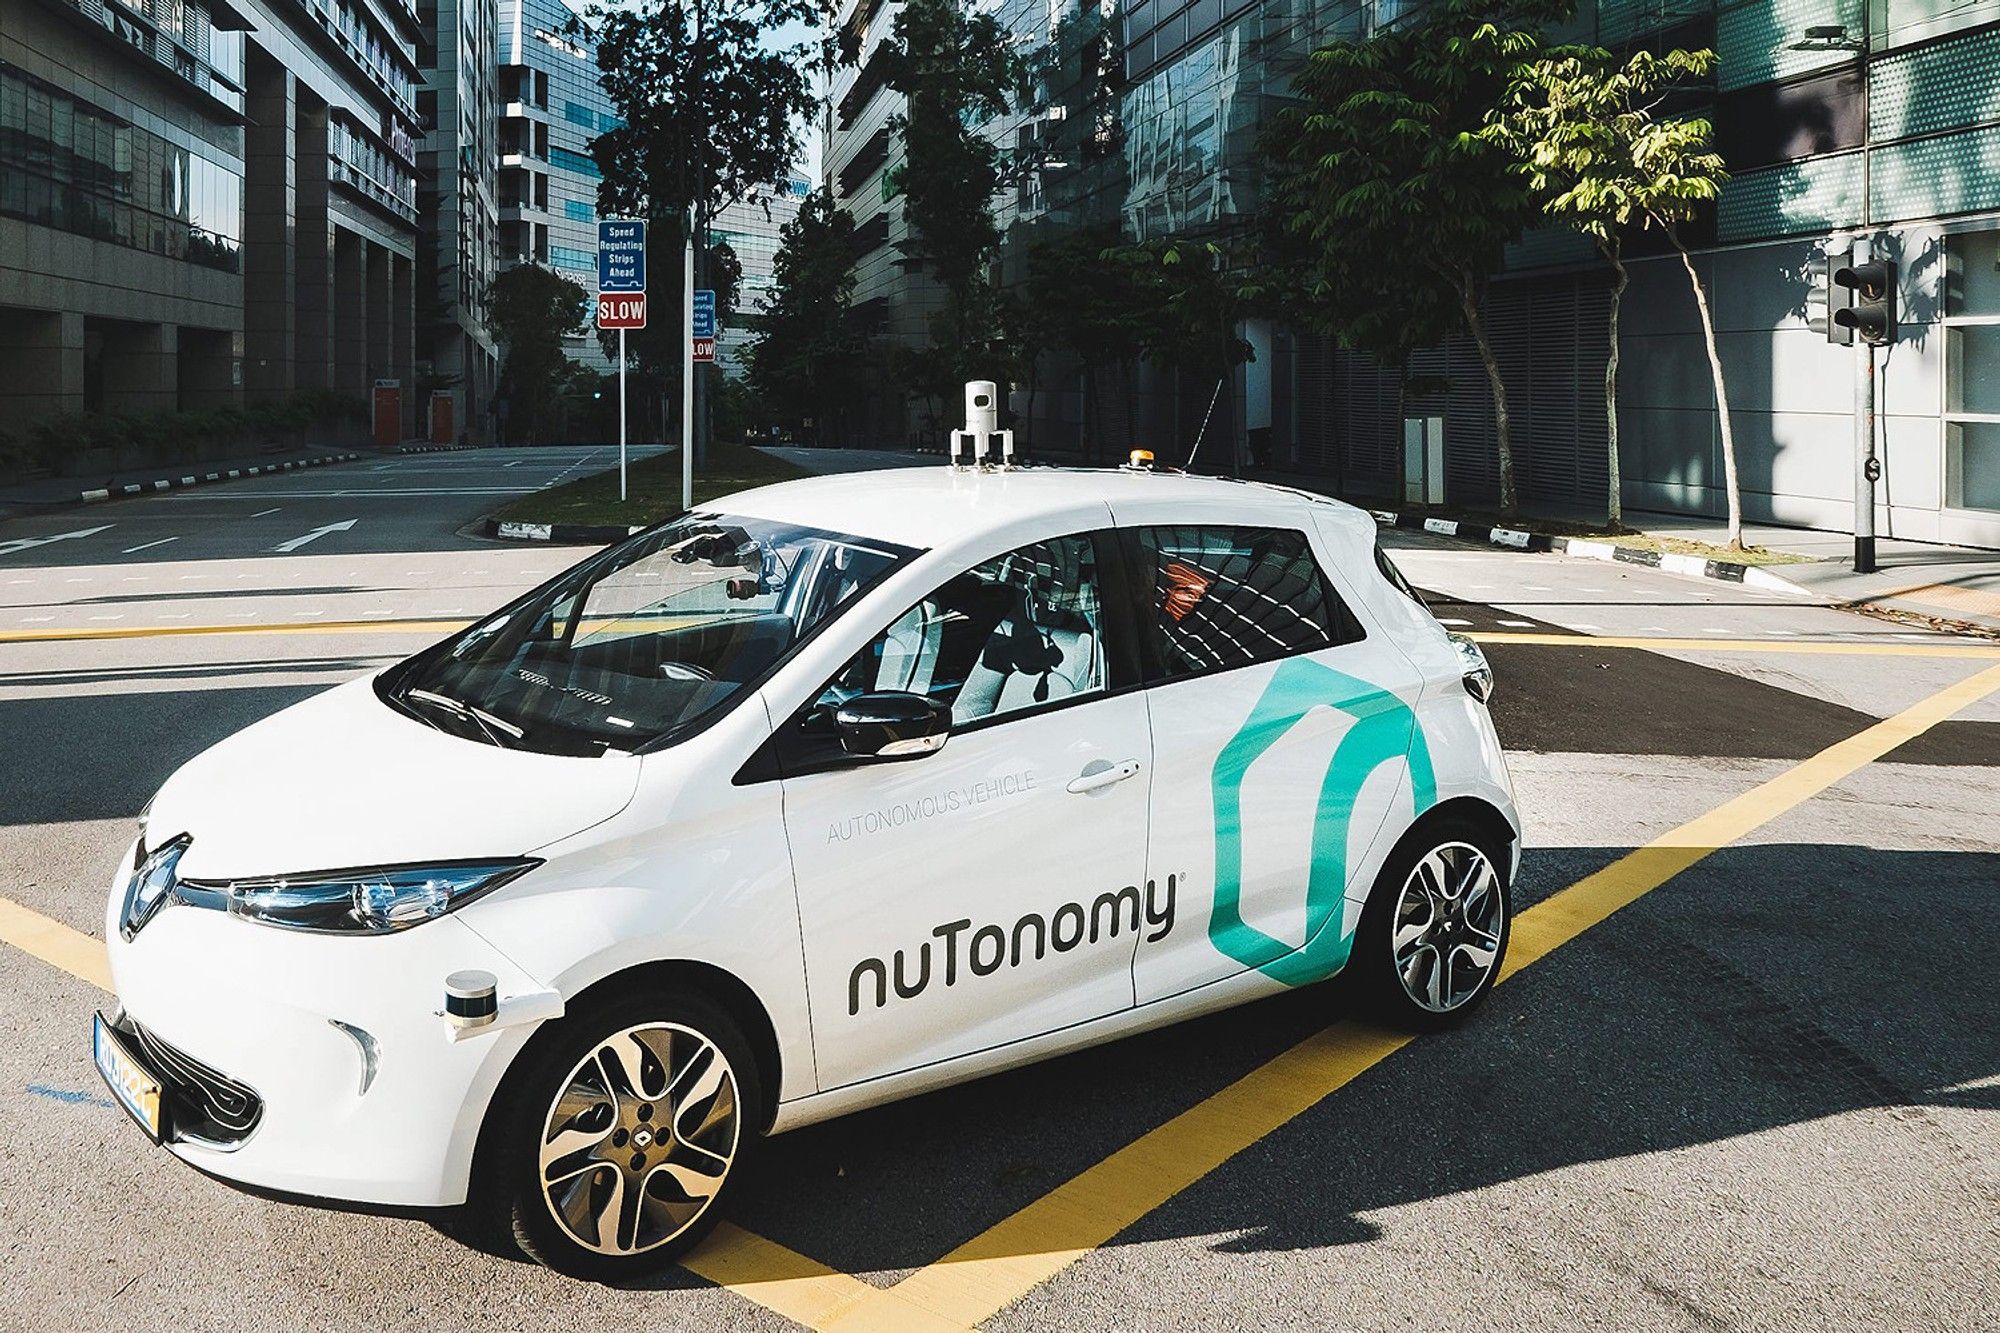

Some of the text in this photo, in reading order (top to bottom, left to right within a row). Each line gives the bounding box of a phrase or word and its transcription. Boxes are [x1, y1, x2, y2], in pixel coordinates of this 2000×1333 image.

[609, 226, 635, 238] Speed
[600, 240, 643, 252] Regulating
[609, 254, 634, 264] Strips
[609, 267, 635, 278] Ahead
[600, 301, 644, 320] SLOW
[692, 342, 714, 356] LOW
[826, 769, 1038, 845] AUTONOMOUS VEHICLE
